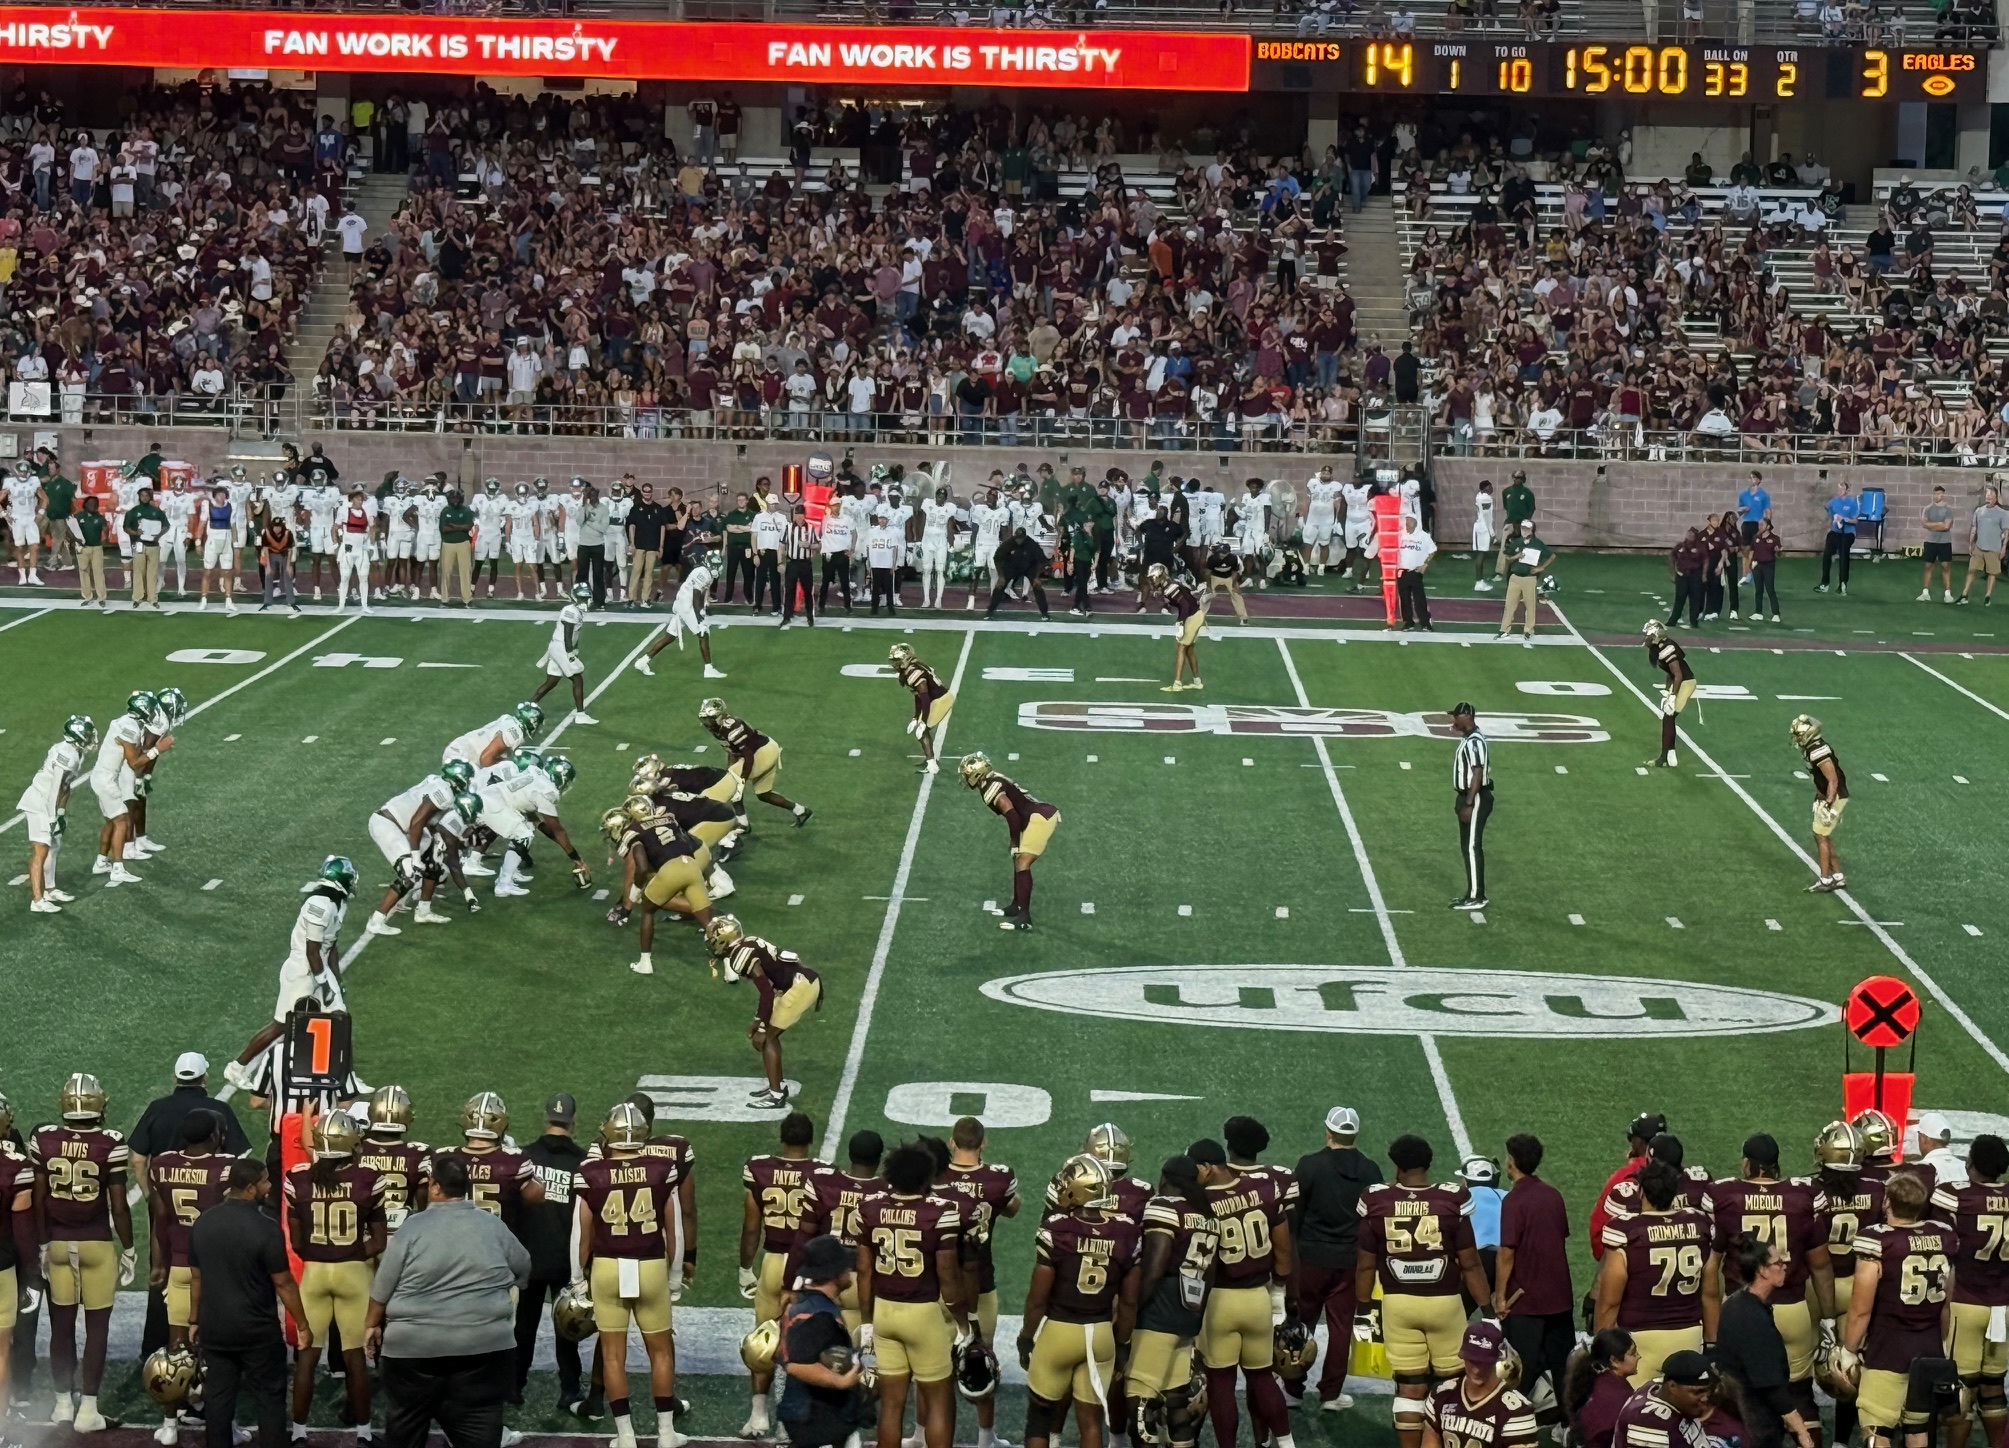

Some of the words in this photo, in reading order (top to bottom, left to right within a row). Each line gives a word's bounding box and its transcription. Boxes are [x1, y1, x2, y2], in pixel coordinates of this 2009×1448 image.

[0, 23, 114, 49] HIRSTY
[265, 30, 328, 55] FAN
[336, 32, 433, 58] WORK
[440, 34, 468, 59] IS
[476, 34, 618, 62] THIRSTY
[1257, 42, 1340, 60] BOBCATS
[1433, 45, 1467, 57] DOWN
[1494, 46, 1508, 57] TO
[1511, 46, 1527, 58] GO
[768, 42, 831, 67] FAN
[839, 43, 936, 69] WORK
[943, 45, 971, 70] IS
[979, 45, 1122, 72] THIRSTY
[1366, 43, 1413, 87] 14
[1565, 46, 1688, 94] 15:00
[1704, 49, 1731, 61] BALL
[1733, 49, 1748, 62] ON
[1776, 51, 1799, 62] QTR
[1903, 54, 1976, 71] EAGLES
[1450, 60, 1460, 89] 1
[1498, 58, 1533, 93] 10
[1705, 63, 1748, 96] 33
[1776, 63, 1797, 97] 2
[1861, 50, 1888, 97] 3
[306, 1018, 331, 1074] 1
[636, 1073, 803, 1123] 3
[884, 1081, 1053, 1129] 0
[61, 1141, 89, 1158] DAVIS
[393, 1156, 408, 1172] JR.
[47, 1157, 100, 1202] 26
[159, 1167, 168, 1183] D.
[168, 1167, 209, 1184] JACKSON
[546, 1181, 569, 1195] LECT
[609, 1166, 647, 1184] KAISER
[772, 1168, 803, 1187] PAYNE
[171, 1188, 201, 1227] 5
[310, 1201, 358, 1246] 10
[600, 1186, 658, 1236] 44
[880, 1207, 917, 1226] COLLINS
[1394, 1200, 1430, 1216] NORRIS
[1077, 1236, 1116, 1257] LANDRY
[1218, 1210, 1273, 1265] 90
[1383, 1215, 1445, 1254] 54
[1741, 1214, 1792, 1263] 71
[1827, 1213, 1859, 1256] 0
[871, 1227, 924, 1278] 35
[1076, 1254, 1110, 1295] 6
[1649, 1244, 1703, 1297] 79
[1899, 1254, 1952, 1306] 63
